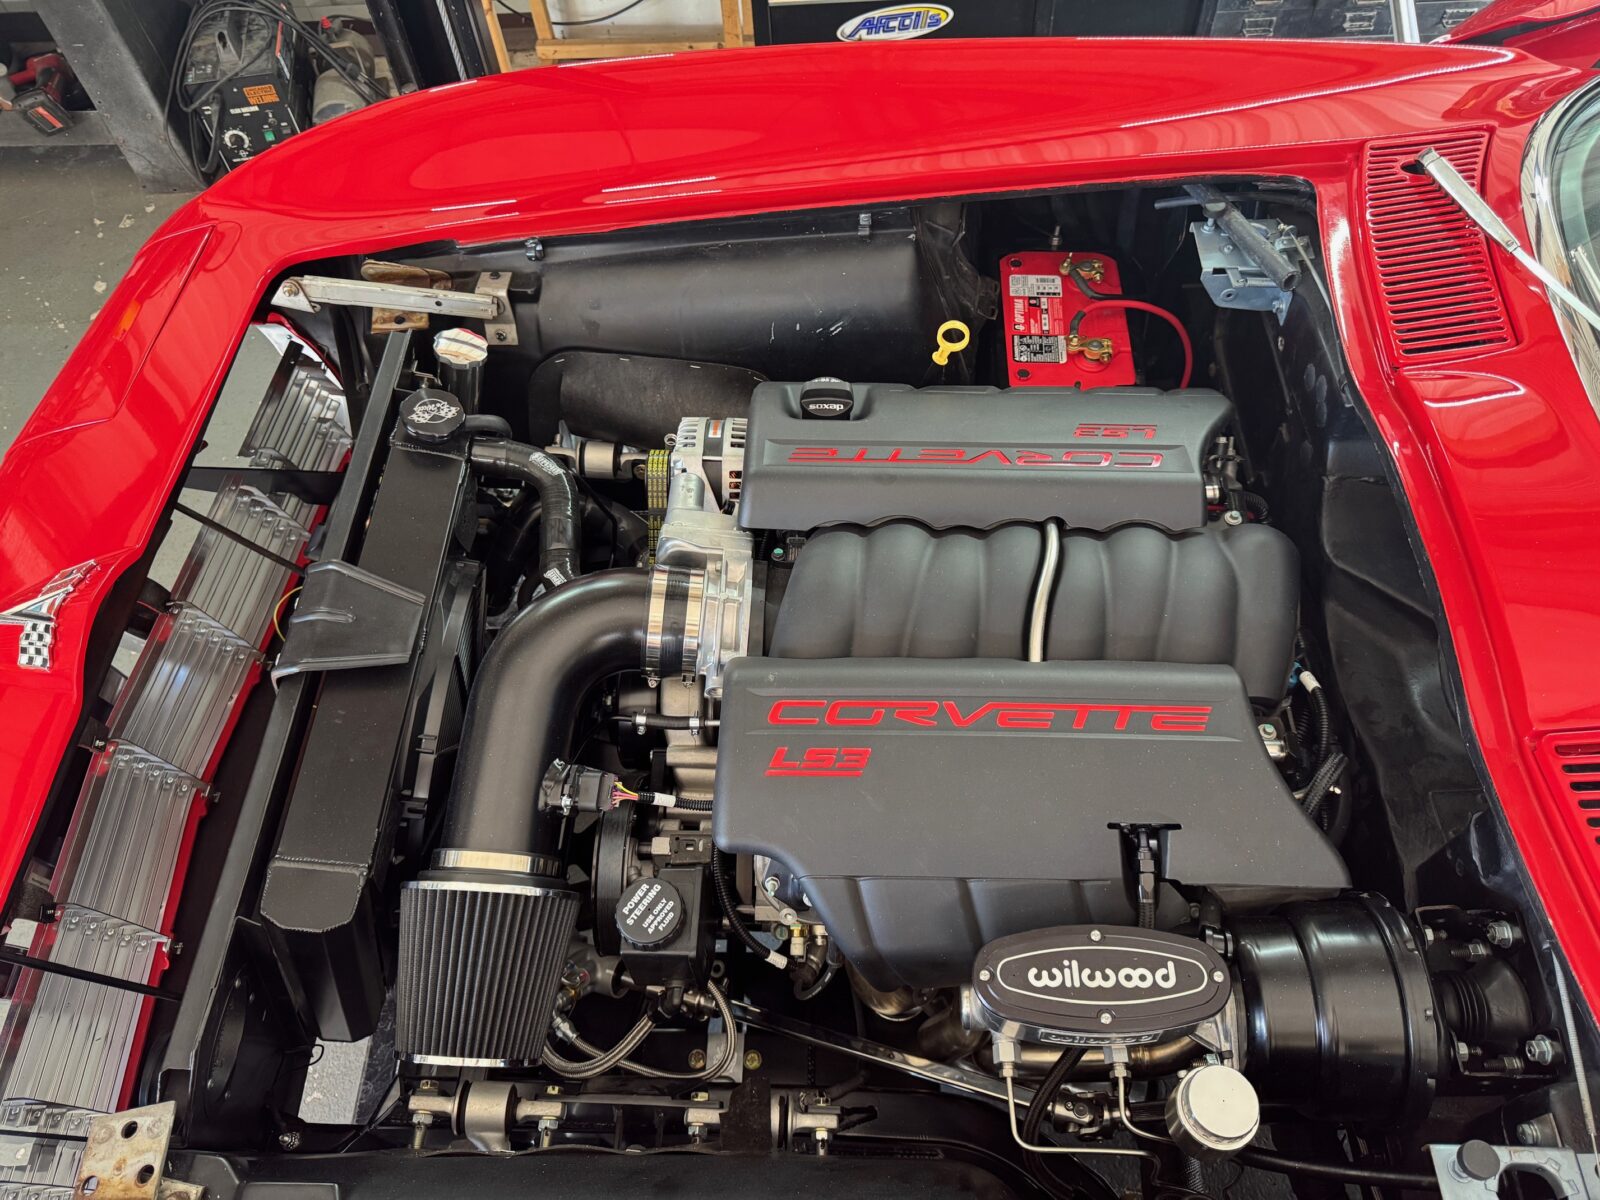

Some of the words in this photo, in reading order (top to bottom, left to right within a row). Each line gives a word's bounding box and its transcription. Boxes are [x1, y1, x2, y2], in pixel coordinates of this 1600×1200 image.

[1014, 299, 1024, 323] OPTIMA
[1073, 426, 1157, 439] LS3
[788, 448, 1163, 468] CORVETTE
[768, 700, 1212, 731] CORVETTE
[768, 747, 871, 768] LS3
[622, 883, 649, 915] POWER
[626, 884, 661, 926] STEERING
[642, 914, 655, 928] USE
[653, 897, 667, 915] ONLY
[647, 900, 674, 934] APPROVED
[658, 912, 674, 931] FLUID
[1028, 959, 1177, 989] wilwood
